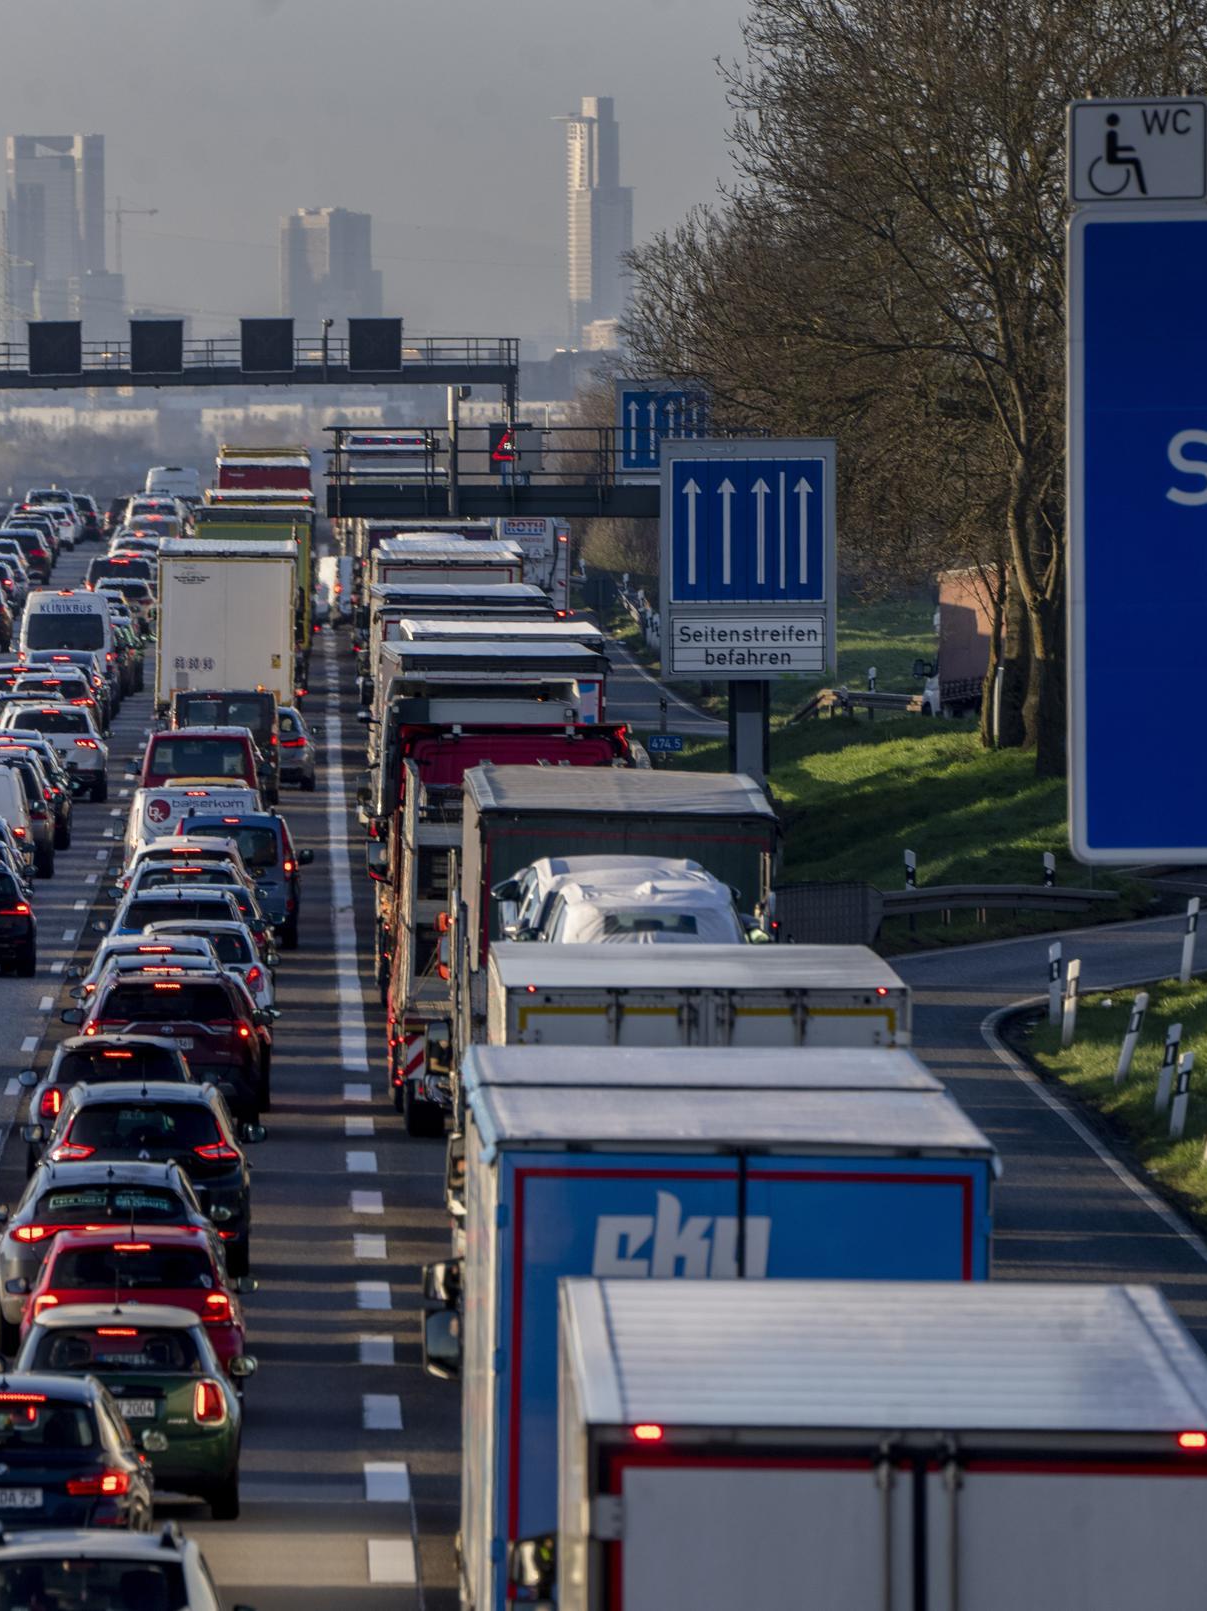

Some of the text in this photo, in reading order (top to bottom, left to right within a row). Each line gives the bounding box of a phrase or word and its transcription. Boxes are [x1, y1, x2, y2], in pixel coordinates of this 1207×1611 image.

[1141, 108, 1191, 135] WC
[507, 521, 544, 533] ROTH
[679, 625, 818, 643] Seitenstreifen
[704, 648, 791, 665] befahren
